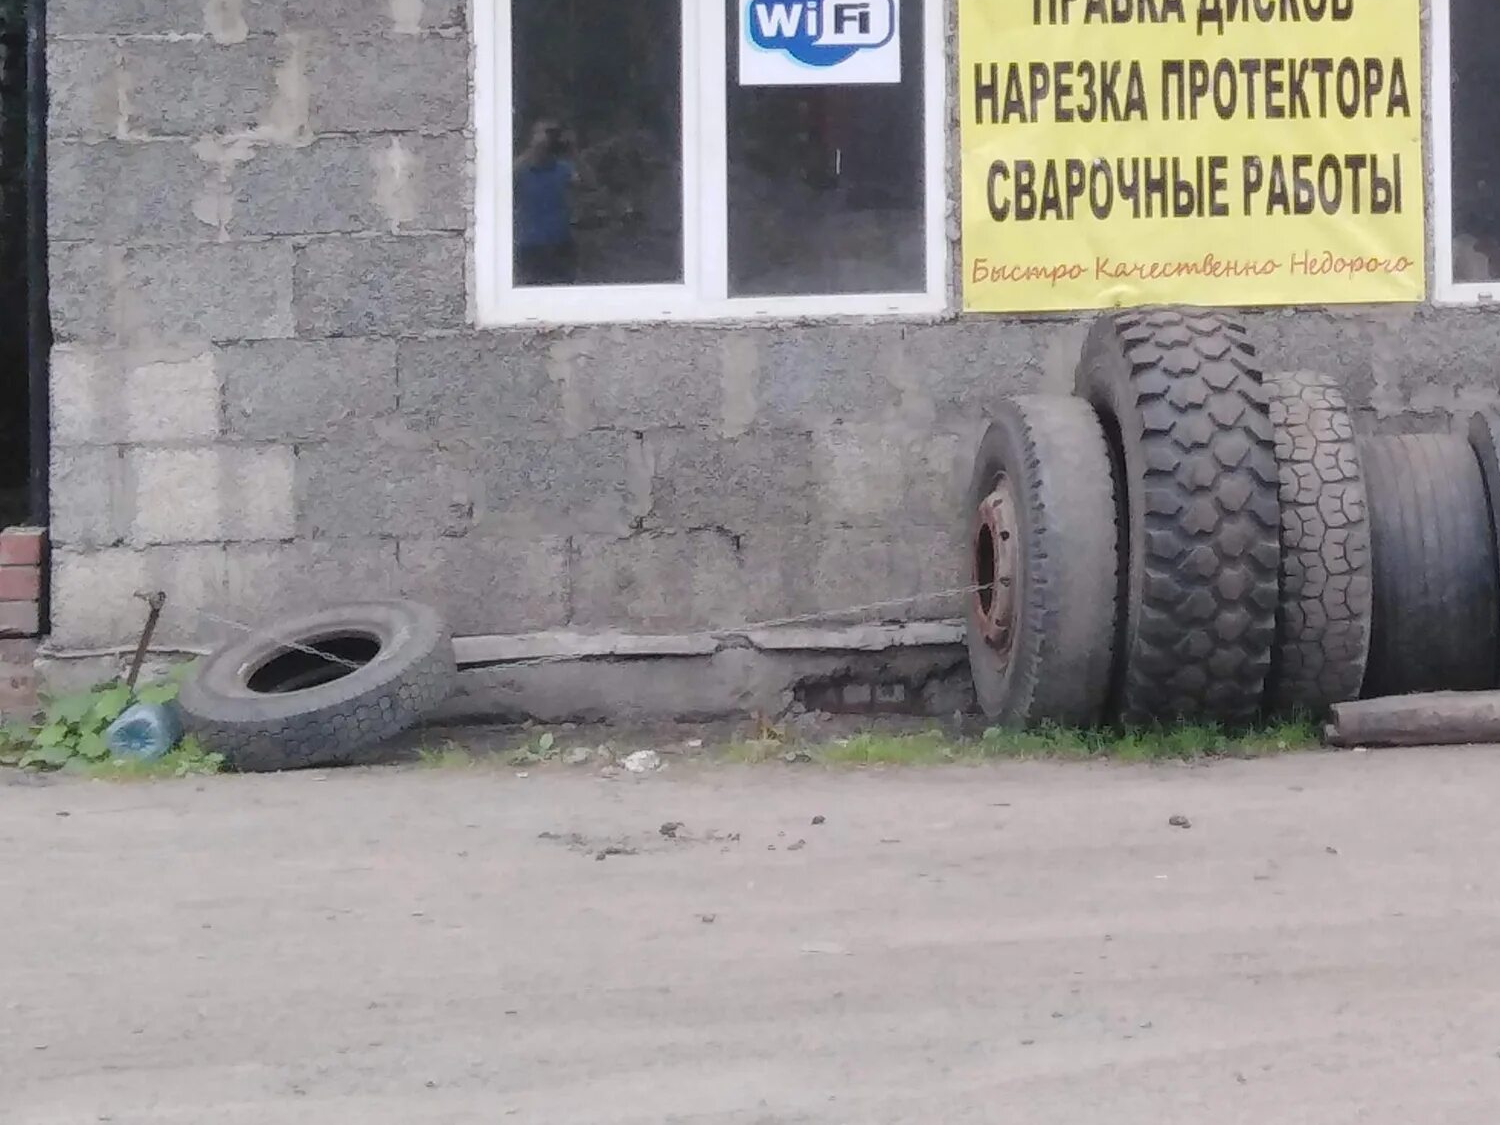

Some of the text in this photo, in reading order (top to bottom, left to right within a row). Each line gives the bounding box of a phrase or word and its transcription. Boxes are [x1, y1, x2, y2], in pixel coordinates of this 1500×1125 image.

[974, 57, 1411, 125] НАРЕЗКА ПРОТЕКТОРА
[987, 152, 1402, 222] СВАРОЧНЫЕ РАБОТЫ
[972, 250, 1414, 287] Быстро Качественно Недорого
